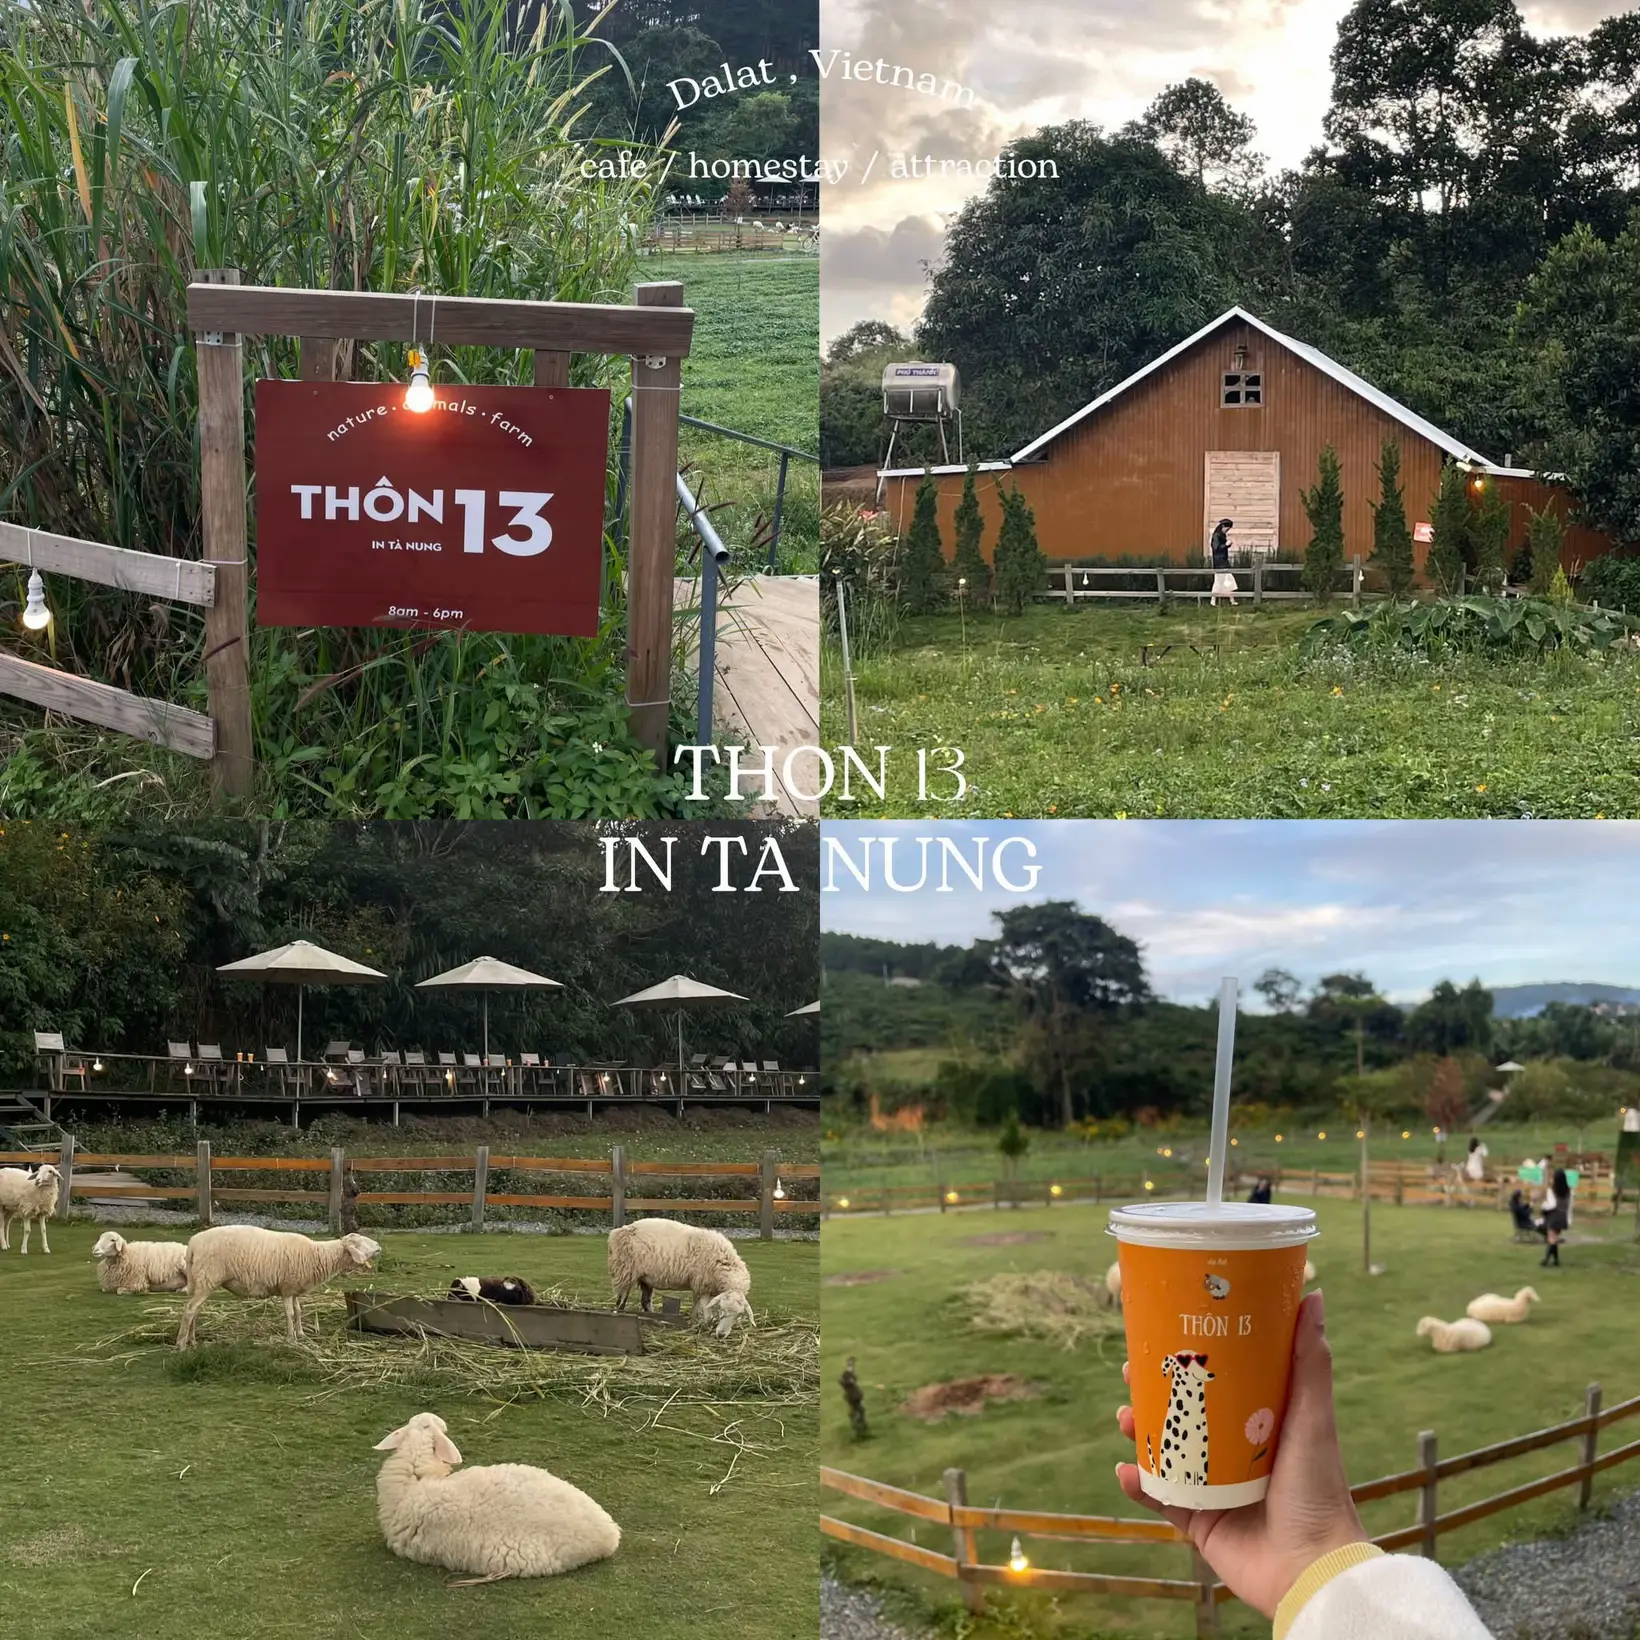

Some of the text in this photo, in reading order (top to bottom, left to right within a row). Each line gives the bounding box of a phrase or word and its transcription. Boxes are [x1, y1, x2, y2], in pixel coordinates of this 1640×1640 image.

[327, 404, 388, 441] nature
[490, 412, 533, 447] farm
[290, 475, 555, 557] THÔN 13
[371, 538, 442, 552] IN TÀ NUNG
[387, 605, 419, 617] 8am
[432, 607, 464, 620] 6pm
[1179, 1312, 1252, 1337] THÔN 13
